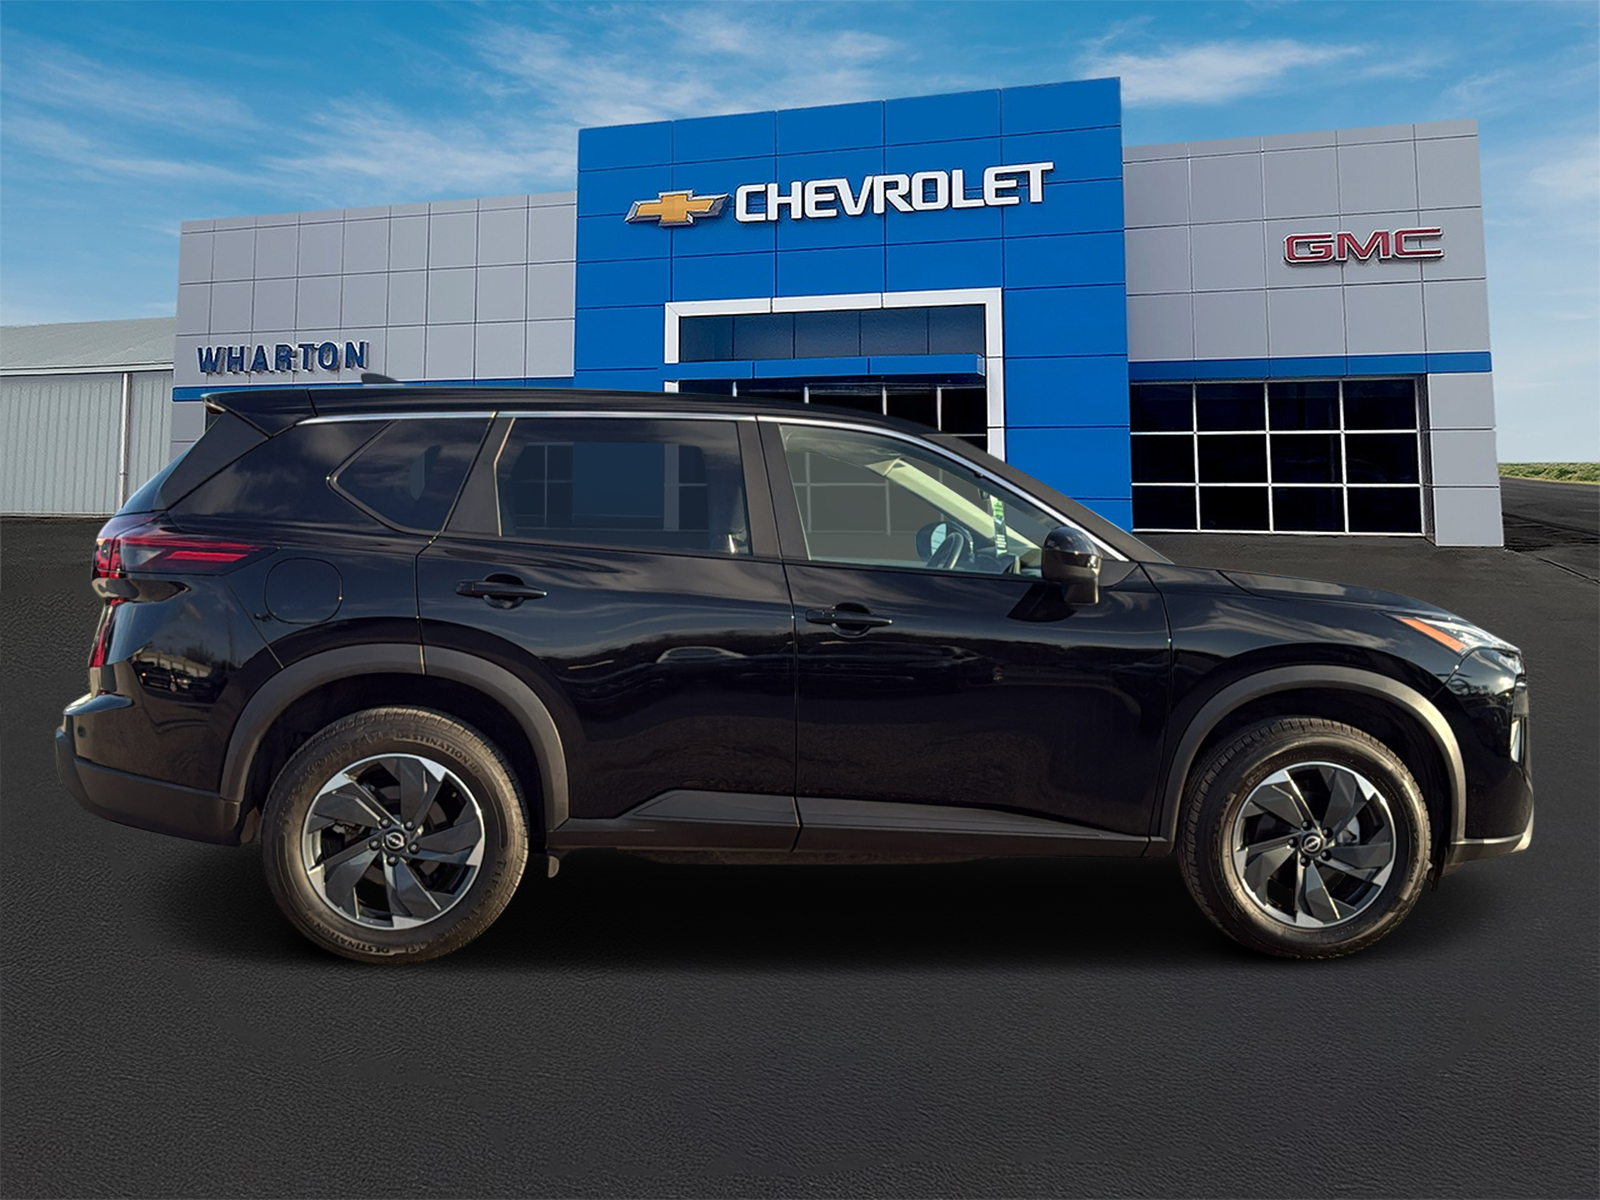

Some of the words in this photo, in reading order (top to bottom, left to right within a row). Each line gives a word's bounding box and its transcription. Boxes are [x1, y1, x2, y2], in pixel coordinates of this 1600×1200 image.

[735, 161, 1054, 223] CHEVROLET
[1284, 226, 1444, 264] GMC
[197, 341, 369, 374] WHARTON
